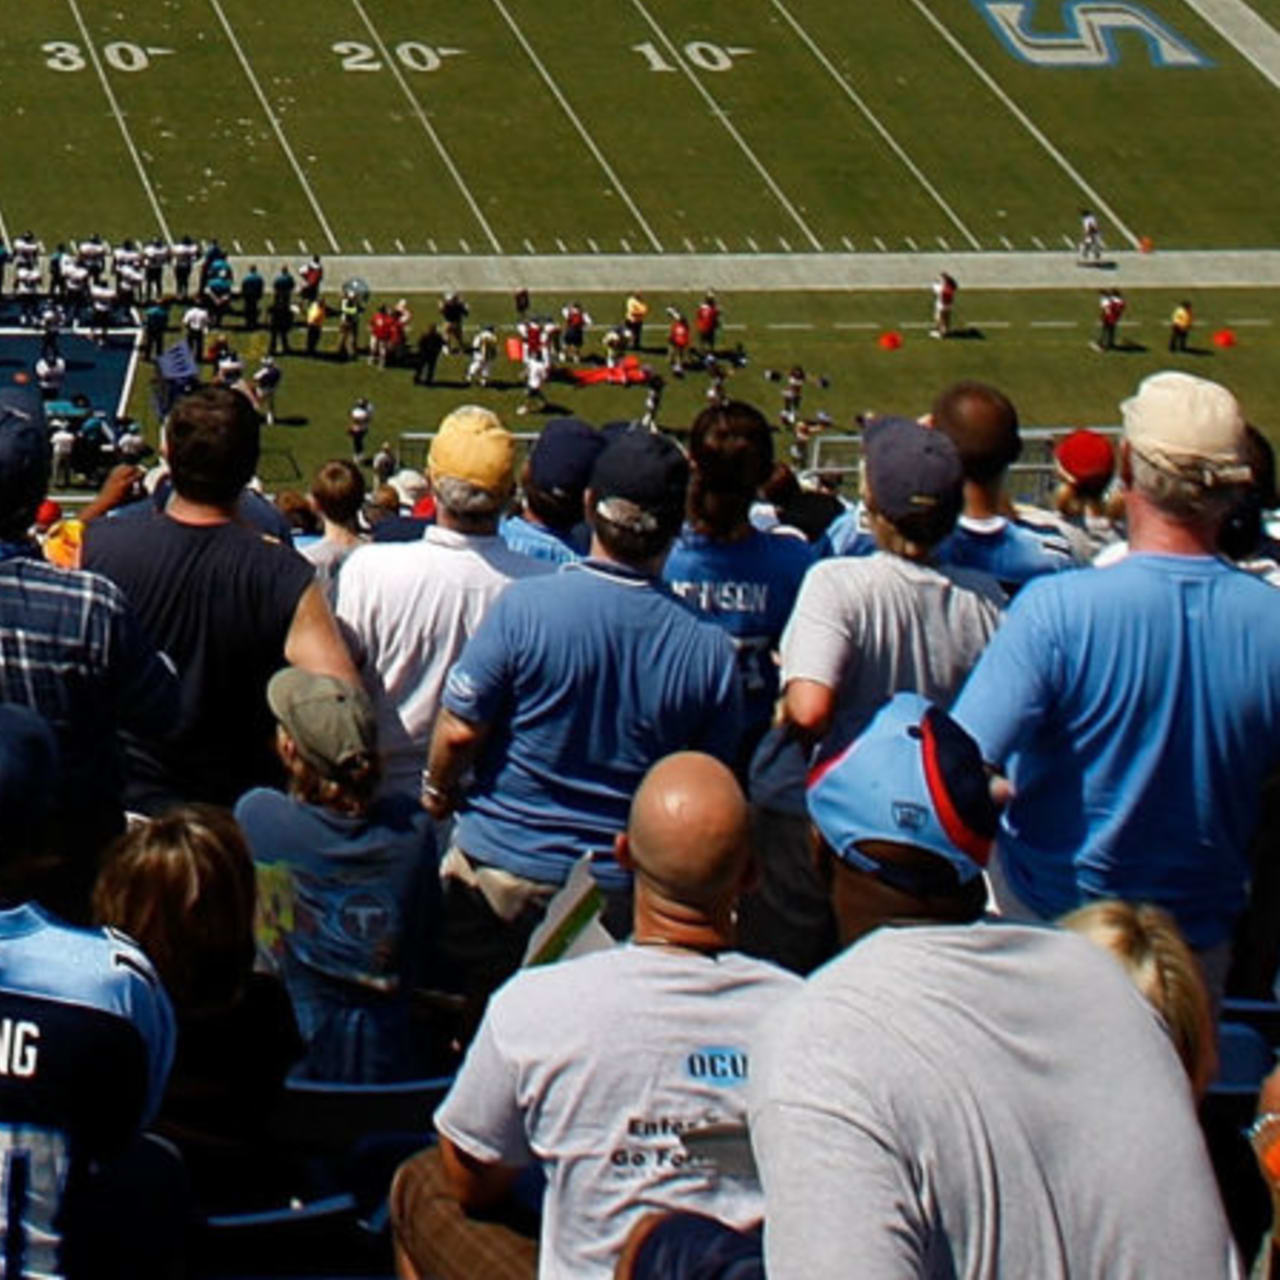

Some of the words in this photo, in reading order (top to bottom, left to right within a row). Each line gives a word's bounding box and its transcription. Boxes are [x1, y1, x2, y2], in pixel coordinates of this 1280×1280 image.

[40, 40, 151, 72] 30
[331, 40, 444, 72] 20
[631, 40, 738, 72] 10
[611, 1149, 645, 1166] Go
